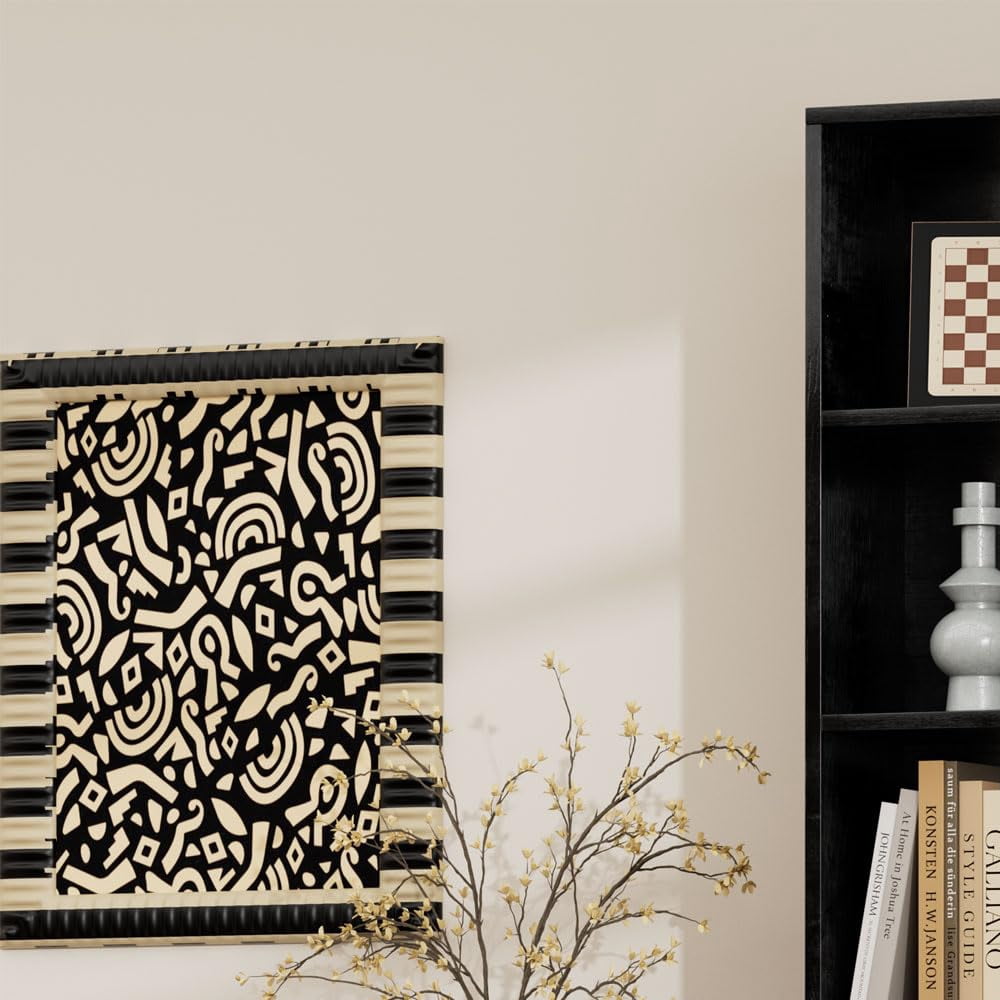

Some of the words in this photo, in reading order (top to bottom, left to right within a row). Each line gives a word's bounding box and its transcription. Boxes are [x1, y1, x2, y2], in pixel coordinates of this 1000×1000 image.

[946, 768, 954, 797] saum
[901, 811, 912, 824] At
[896, 828, 910, 859] Home
[925, 805, 937, 879] KONSTEN
[946, 822, 957, 843] alla
[893, 863, 903, 873] in
[946, 847, 957, 864] die
[963, 833, 975, 900] STYLE
[887, 874, 902, 913] Joshua
[883, 916, 896, 940] Tree
[923, 891, 937, 990] H.W.JANSON
[946, 927, 956, 946] lise
[963, 910, 975, 979] GUIDE
